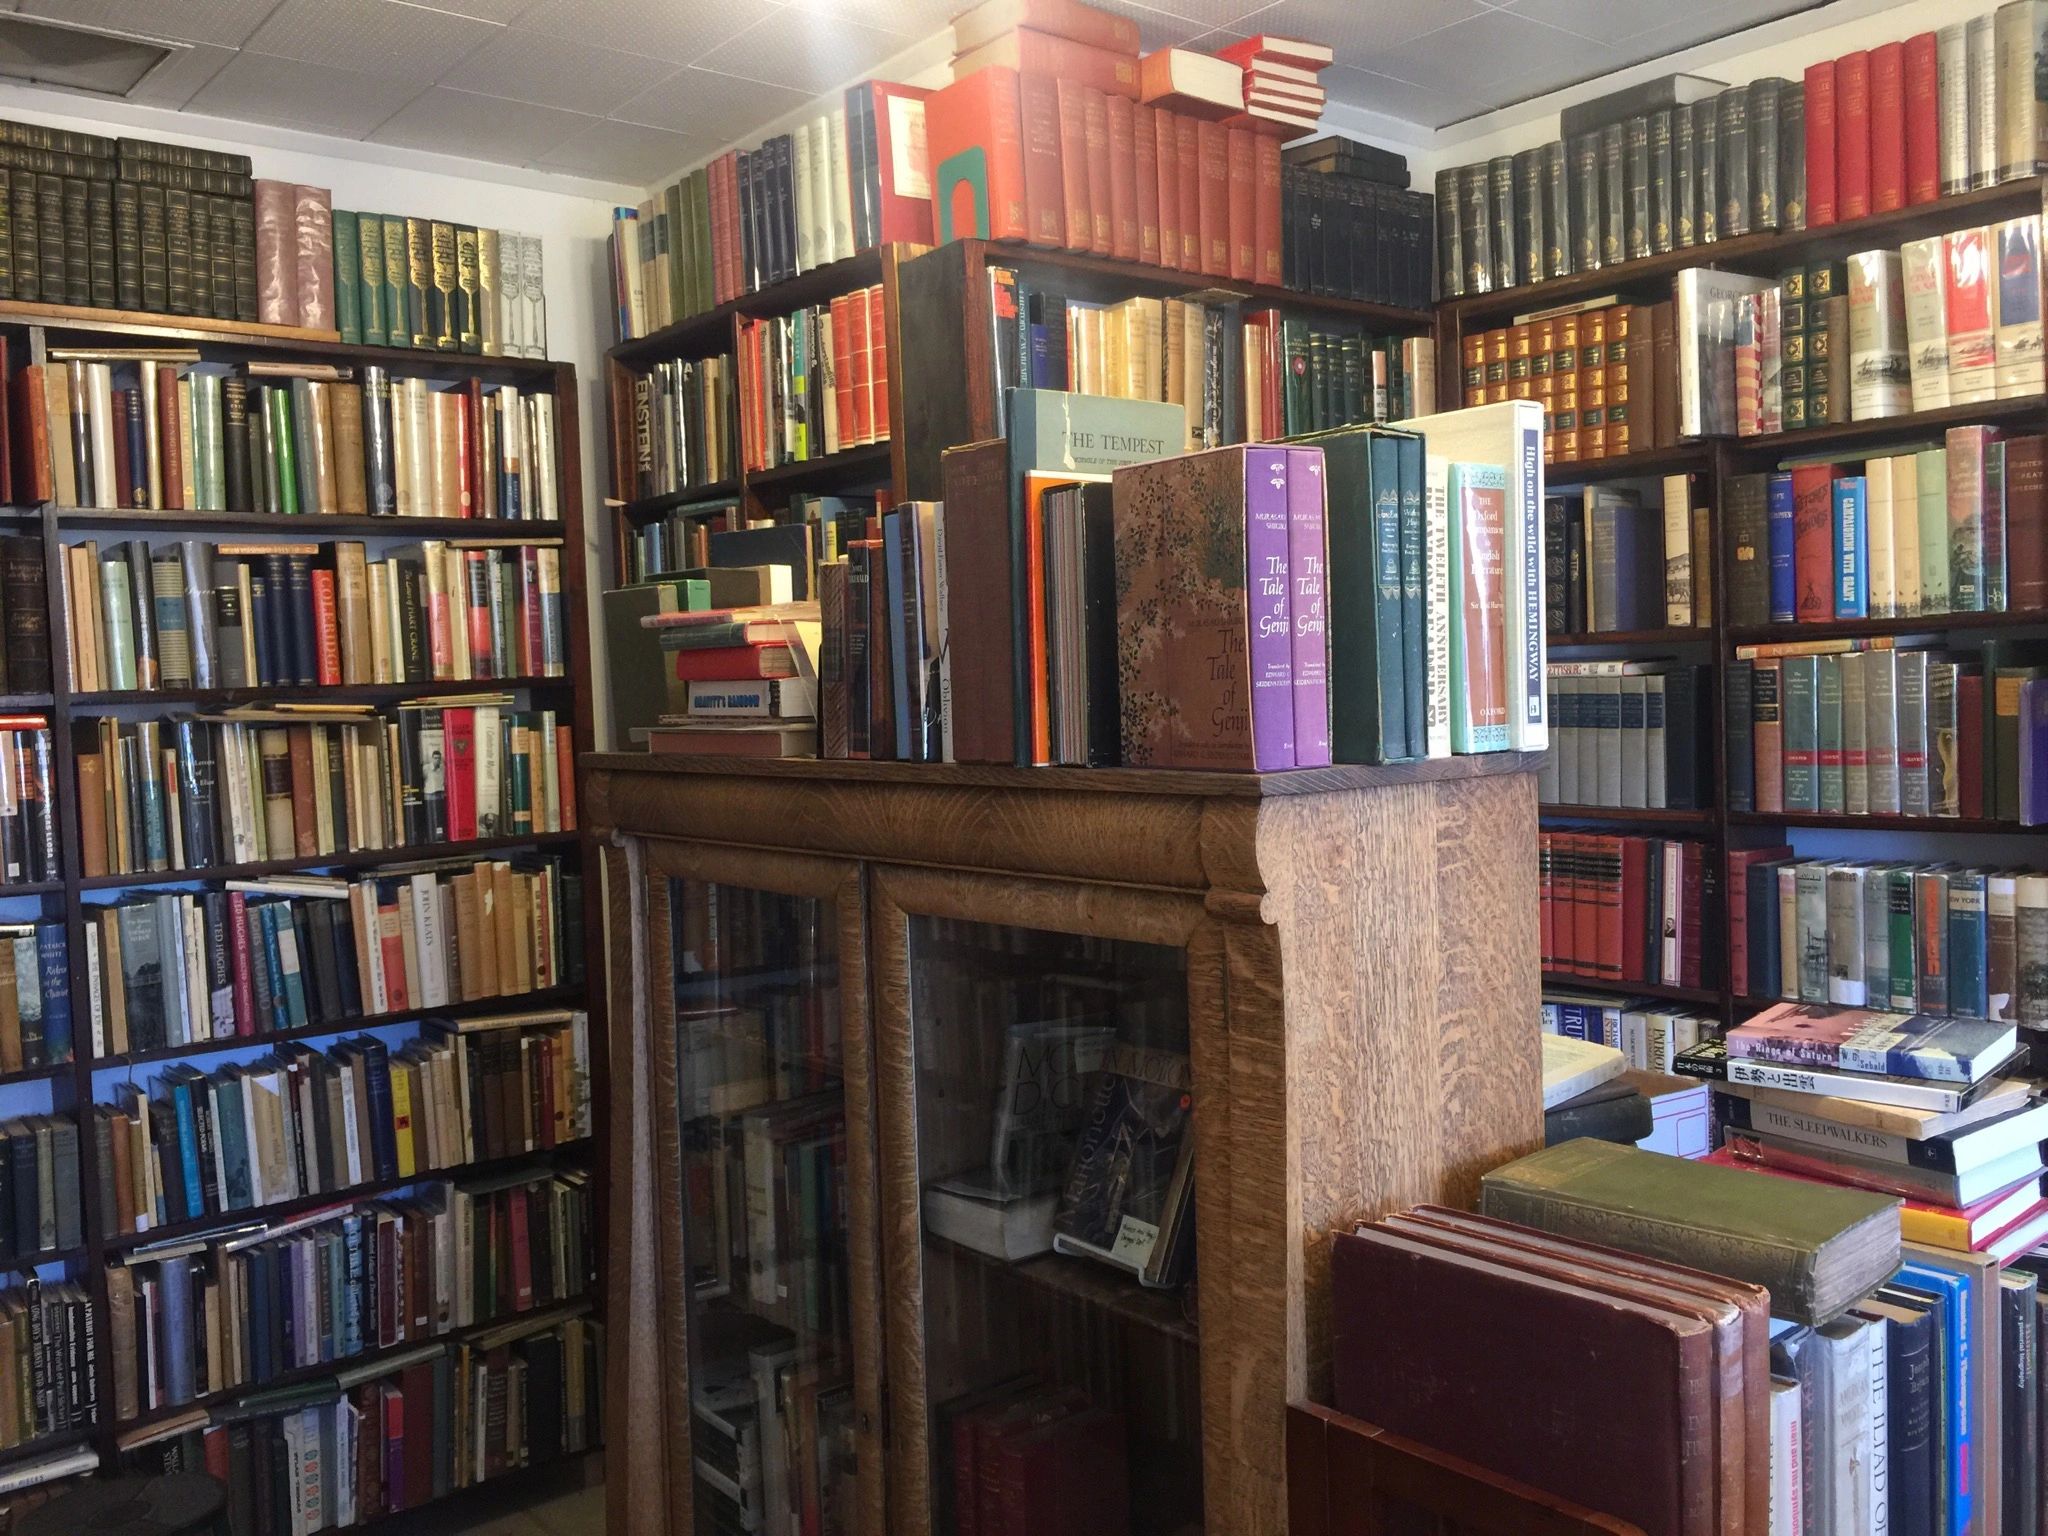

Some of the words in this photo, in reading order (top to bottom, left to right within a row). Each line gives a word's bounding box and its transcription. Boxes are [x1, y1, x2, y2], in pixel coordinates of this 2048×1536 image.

[635, 380, 650, 462] EINSTEIN
[1101, 434, 1165, 455] TEMPEST
[1525, 446, 1536, 477] High
[1527, 481, 1535, 497] on
[1435, 486, 1445, 519] THE
[1474, 510, 1498, 521] Oxford
[1527, 500, 1536, 521] the
[1527, 523, 1537, 553] wild
[1266, 556, 1288, 574] The
[1303, 556, 1324, 574] The
[1435, 526, 1446, 603] TWELFTH
[1471, 563, 1503, 575] Lrature
[1480, 550, 1500, 562] nglish
[1843, 553, 1855, 574] WITH
[1528, 557, 1537, 586] with
[1259, 577, 1284, 595] Tale
[1297, 577, 1321, 595] Tale
[1843, 576, 1855, 602] GRANT
[408, 607, 418, 629] HART
[1273, 597, 1285, 615] of
[1310, 597, 1321, 615] of
[320, 577, 339, 681] COLERIDGE
[1259, 616, 1289, 639] Genji
[1297, 616, 1325, 638] Genji
[1529, 591, 1539, 681] HEMINGWAY
[410, 632, 419, 661] CRANE
[1217, 628, 1245, 654] The
[1206, 654, 1236, 681] Tale
[1436, 611, 1448, 726] ANNIVERSARY
[941, 679, 952, 734] Oblivion
[1223, 680, 1237, 712] of
[1211, 706, 1249, 738] Genji
[46, 832, 54, 859] LLOSA
[233, 899, 244, 914] TED
[1961, 896, 1981, 905] YORK
[213, 922, 225, 942] TED
[236, 916, 246, 951] HUGHES
[40, 942, 66, 950] PATRICK
[215, 944, 227, 985] HUGHES
[1565, 1008, 1582, 1042] TRU
[1611, 1018, 1620, 1048] RICHAR
[1736, 1040, 1753, 1050] The
[1801, 1047, 1833, 1062] Saturn
[1734, 1065, 1816, 1090] 伊勢と出雲
[1860, 1059, 1886, 1072] Sebald
[1766, 1112, 1793, 1128] THE
[1795, 1119, 1889, 1149] SLEEPWALKERS
[31, 1304, 40, 1321] LONG
[85, 1308, 94, 1336] PATRIOT
[86, 1337, 95, 1350] FOR
[1872, 1337, 1885, 1404] THE
[2018, 1353, 2026, 1389] biography
[1873, 1413, 1887, 1493] ILIAD
